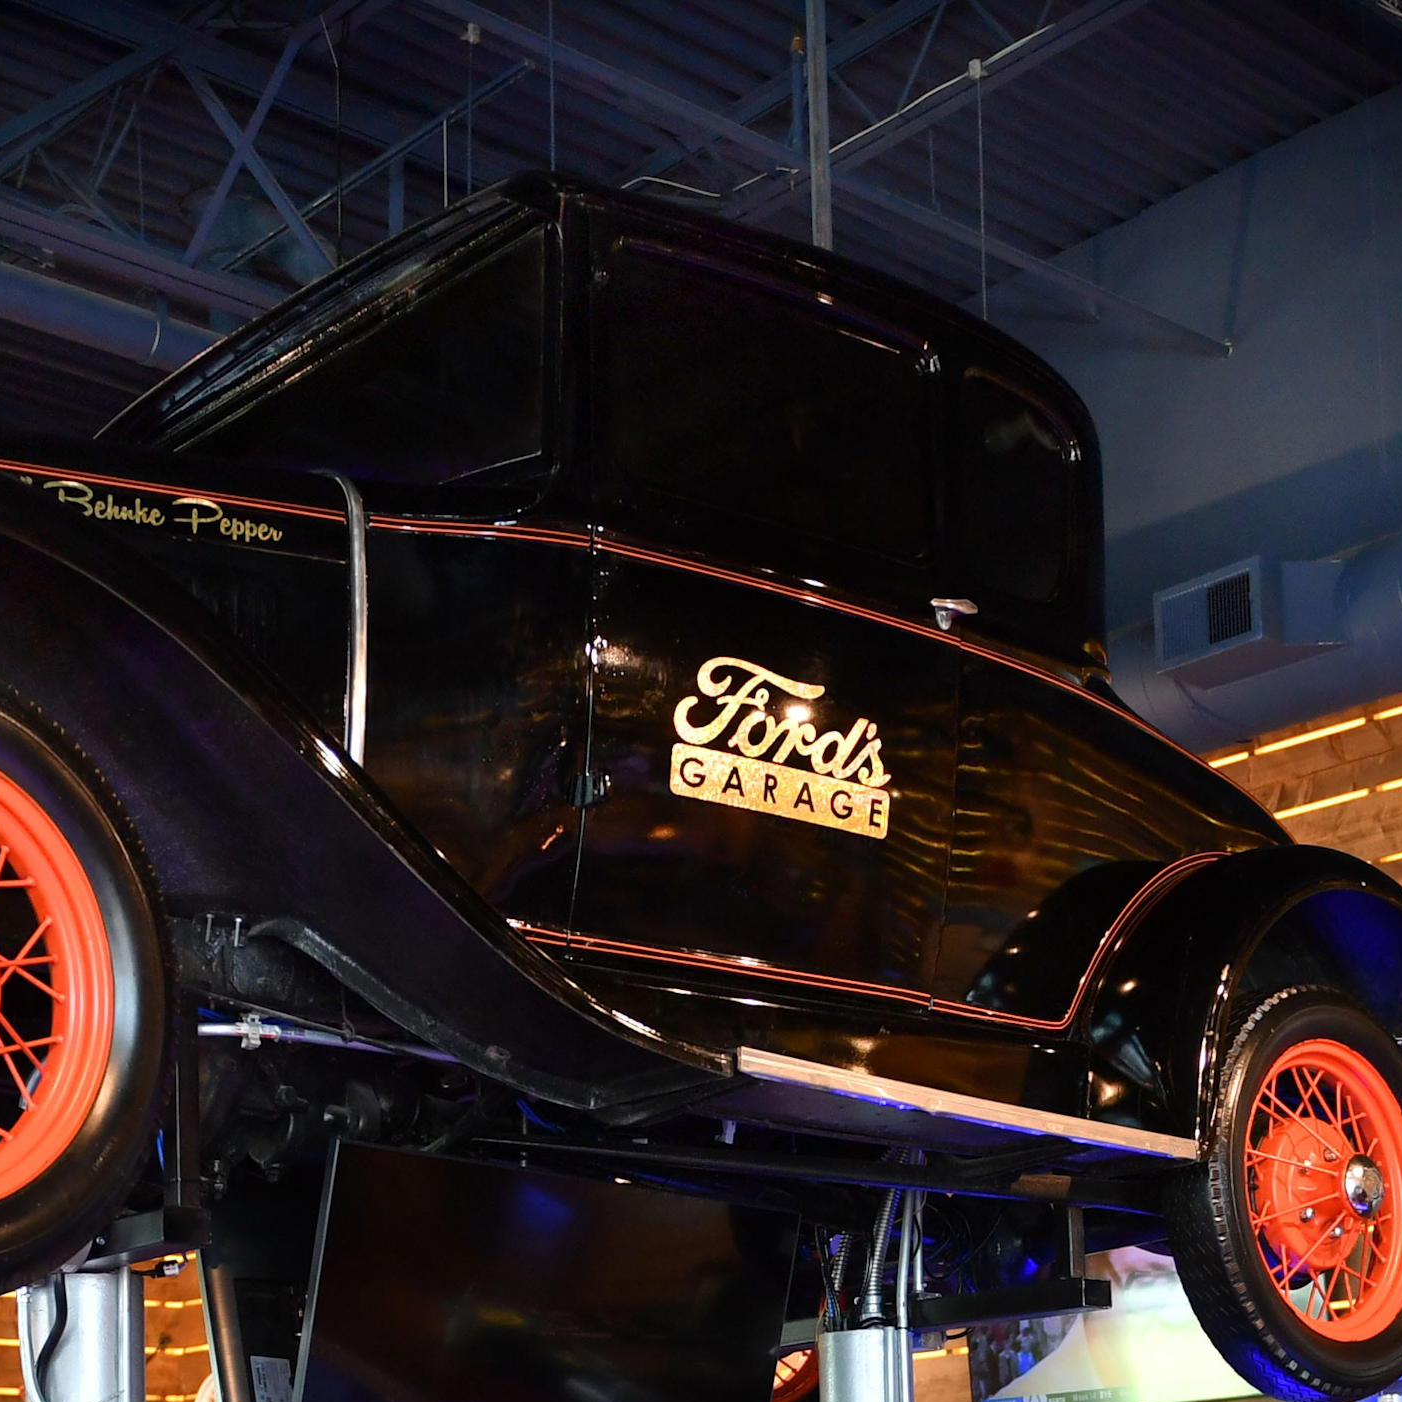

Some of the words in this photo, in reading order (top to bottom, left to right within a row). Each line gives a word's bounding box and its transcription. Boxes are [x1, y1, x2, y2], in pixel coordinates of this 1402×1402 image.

[43, 481, 165, 526] Behnke
[172, 497, 282, 542] Pepper
[673, 656, 891, 787] Ford's
[679, 758, 883, 828] GARAGE
